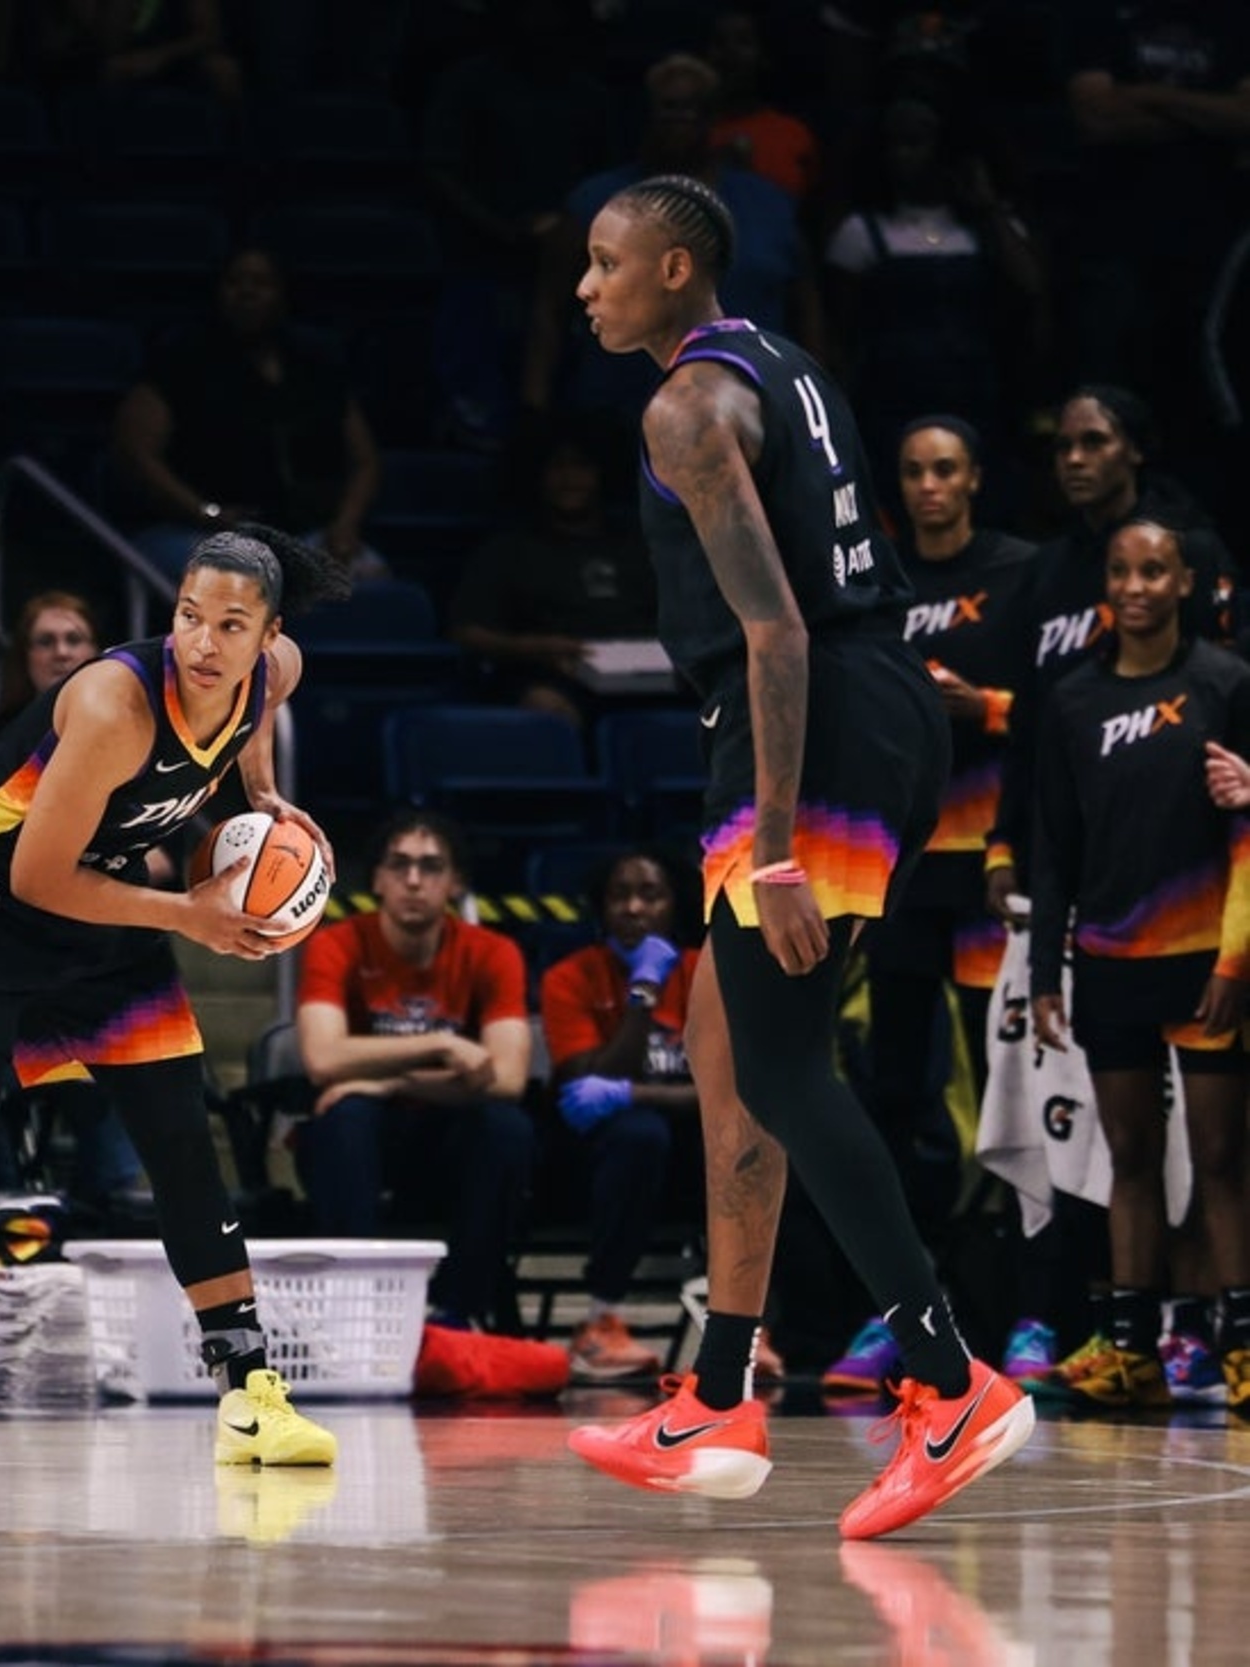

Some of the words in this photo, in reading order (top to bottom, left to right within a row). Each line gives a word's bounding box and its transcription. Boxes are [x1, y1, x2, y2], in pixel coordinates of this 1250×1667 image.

[794, 374, 839, 467] 4
[902, 590, 989, 642] PHX
[1100, 693, 1188, 757] PHX
